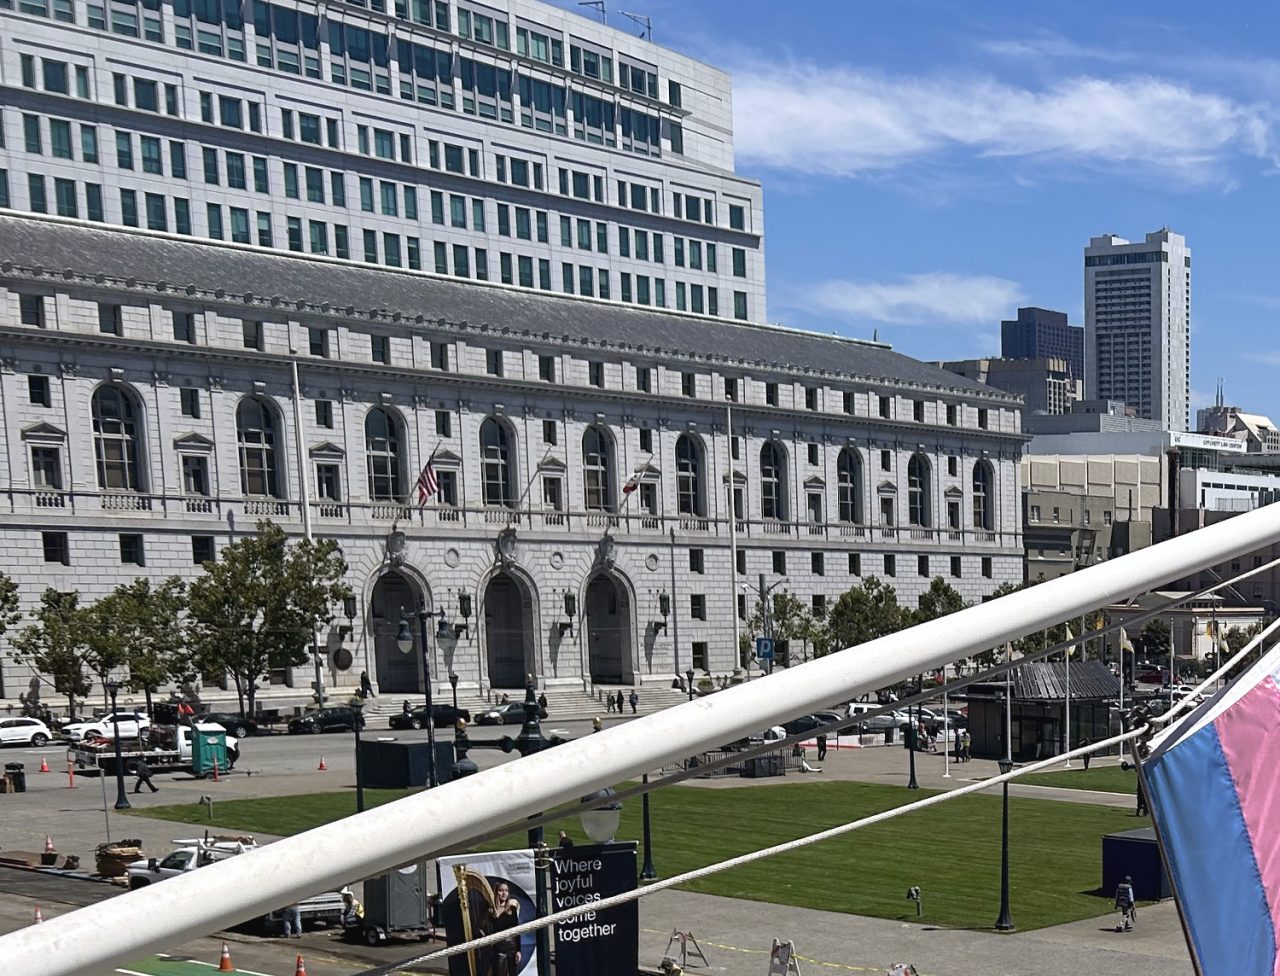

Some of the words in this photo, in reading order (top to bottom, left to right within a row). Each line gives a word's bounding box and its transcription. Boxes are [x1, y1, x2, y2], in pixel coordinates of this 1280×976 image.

[760, 640, 771, 657] P
[555, 859, 602, 874] Where
[555, 874, 593, 894] joyful
[557, 892, 601, 908] voices
[558, 922, 617, 942] together
